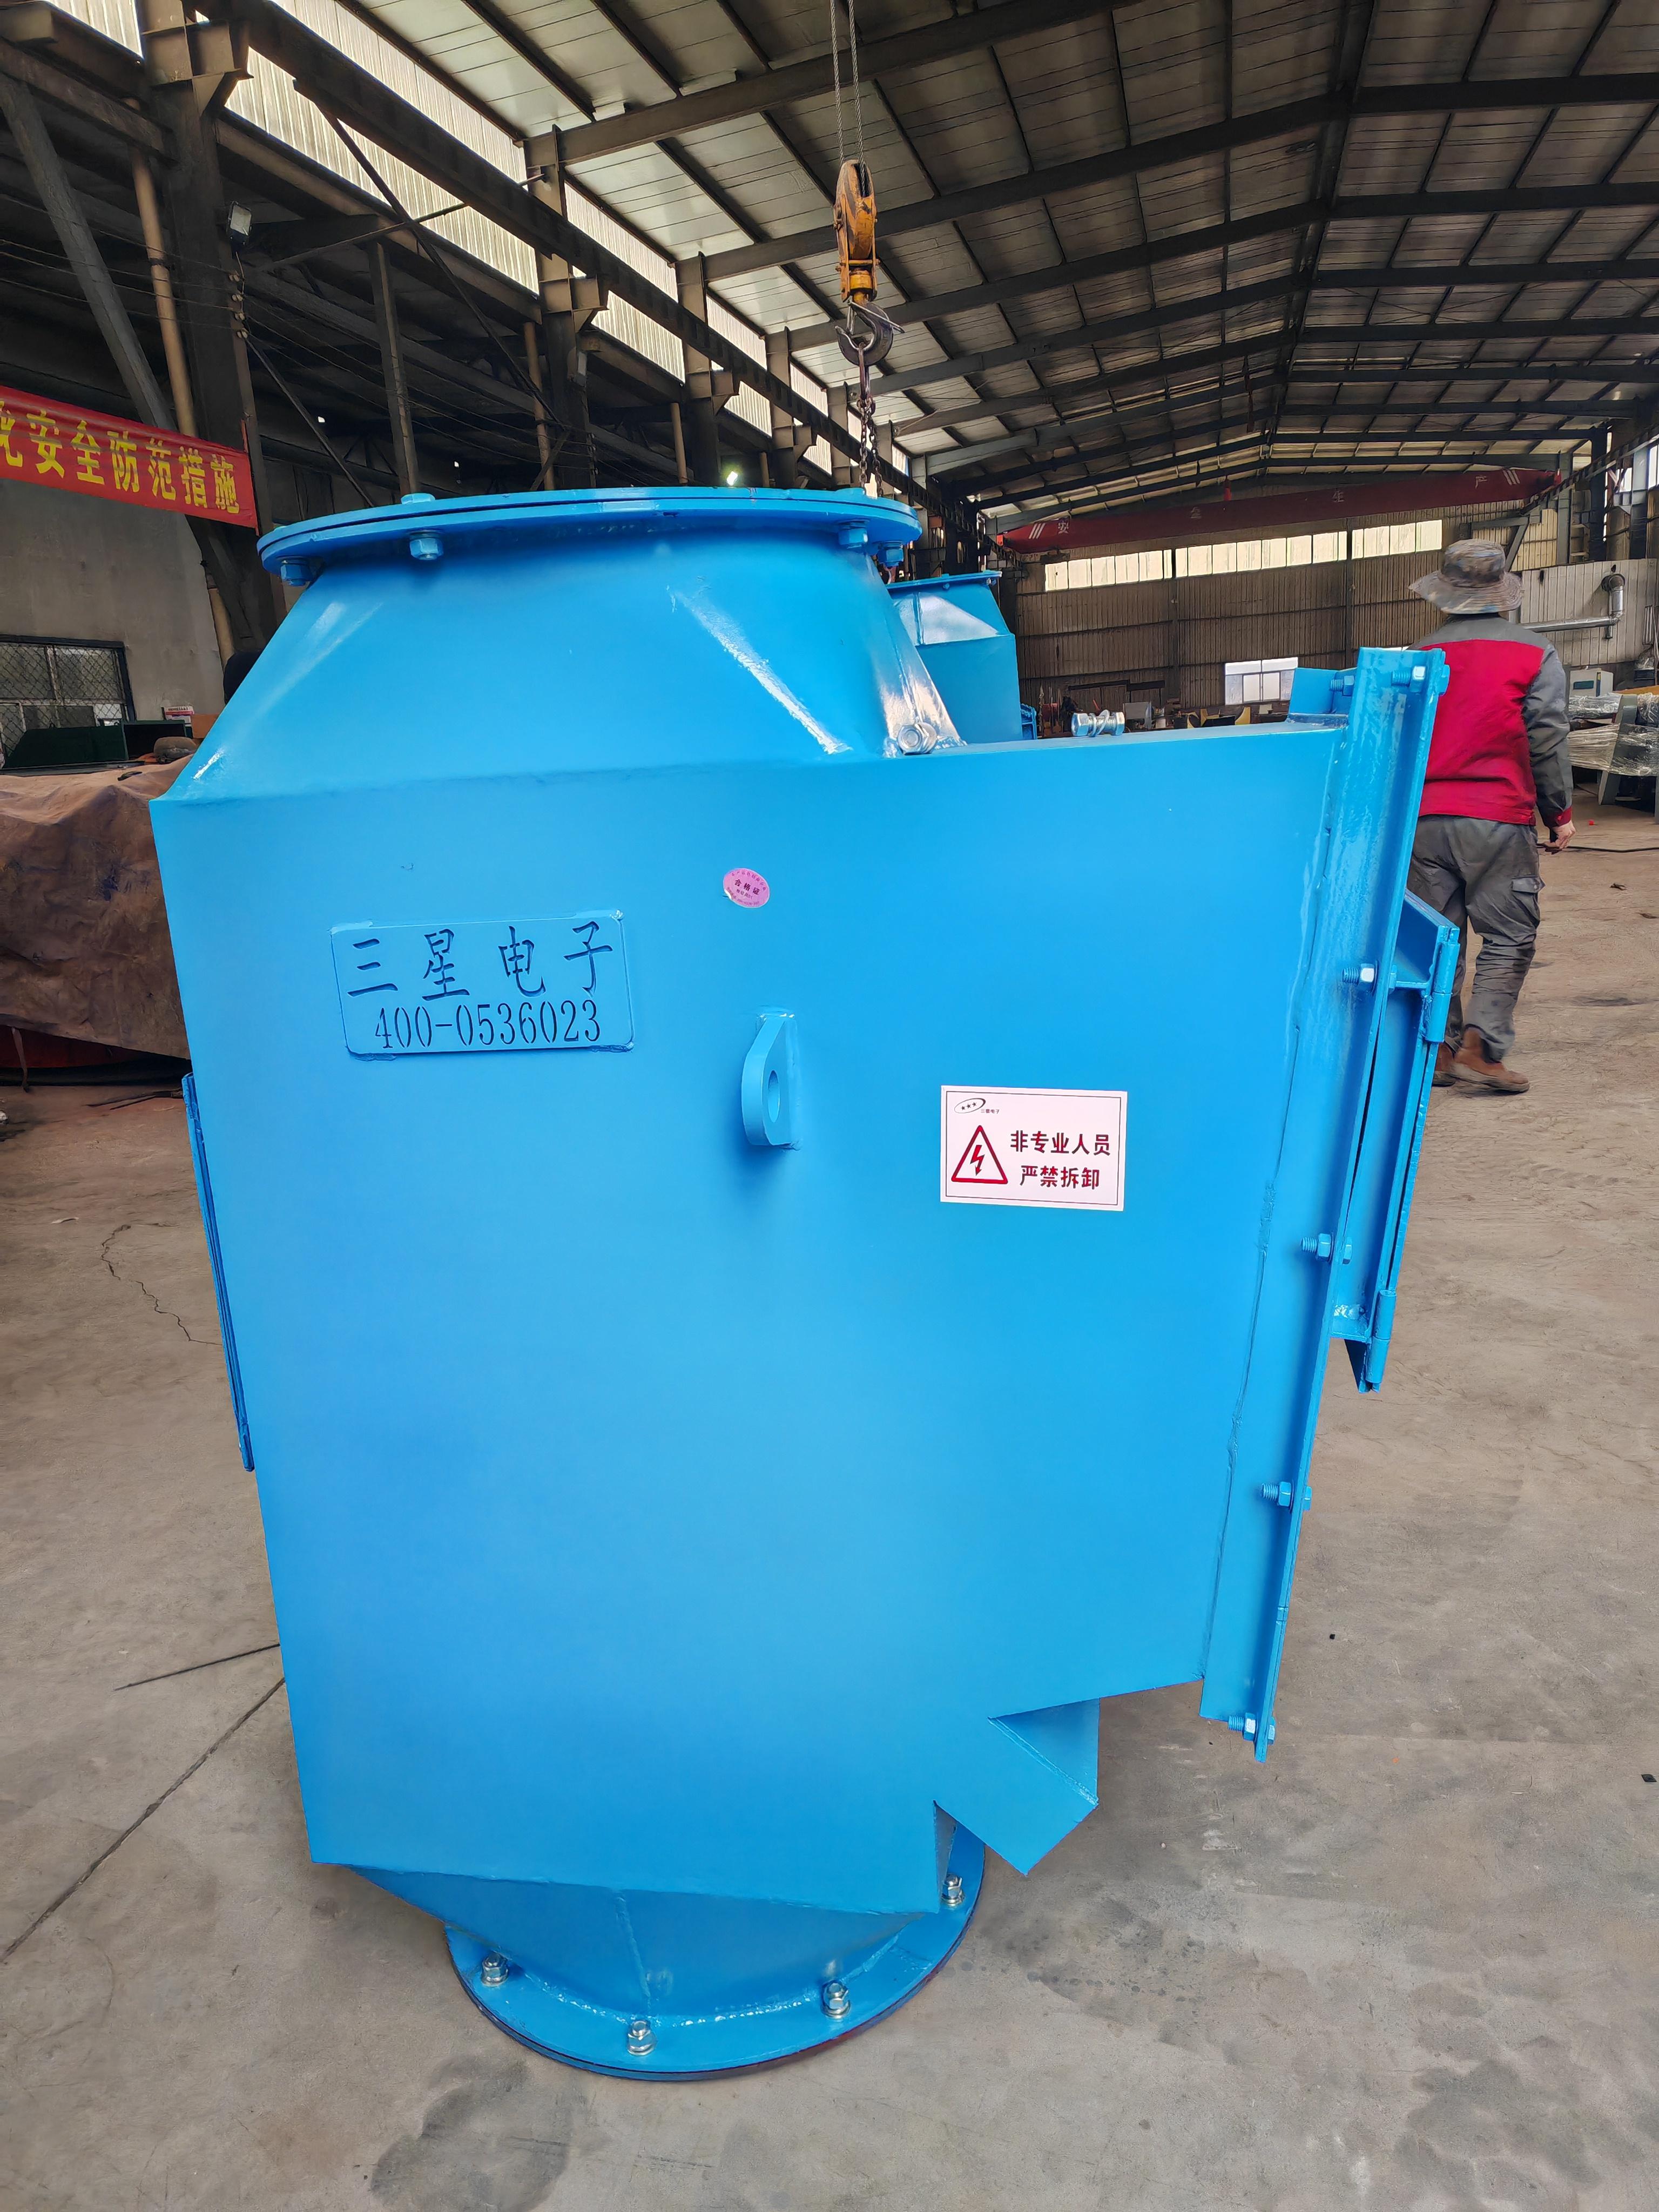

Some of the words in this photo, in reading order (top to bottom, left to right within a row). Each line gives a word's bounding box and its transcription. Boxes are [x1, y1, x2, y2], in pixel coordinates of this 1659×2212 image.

[1057, 521, 1069, 534] 安
[734, 879, 760, 895] 合格证
[347, 921, 613, 1001] 三星电子
[375, 999, 601, 1049] 400-0536023
[1010, 1130, 1110, 1156] 非专业人员
[1020, 1165, 1100, 1190] 严禁拆卸
